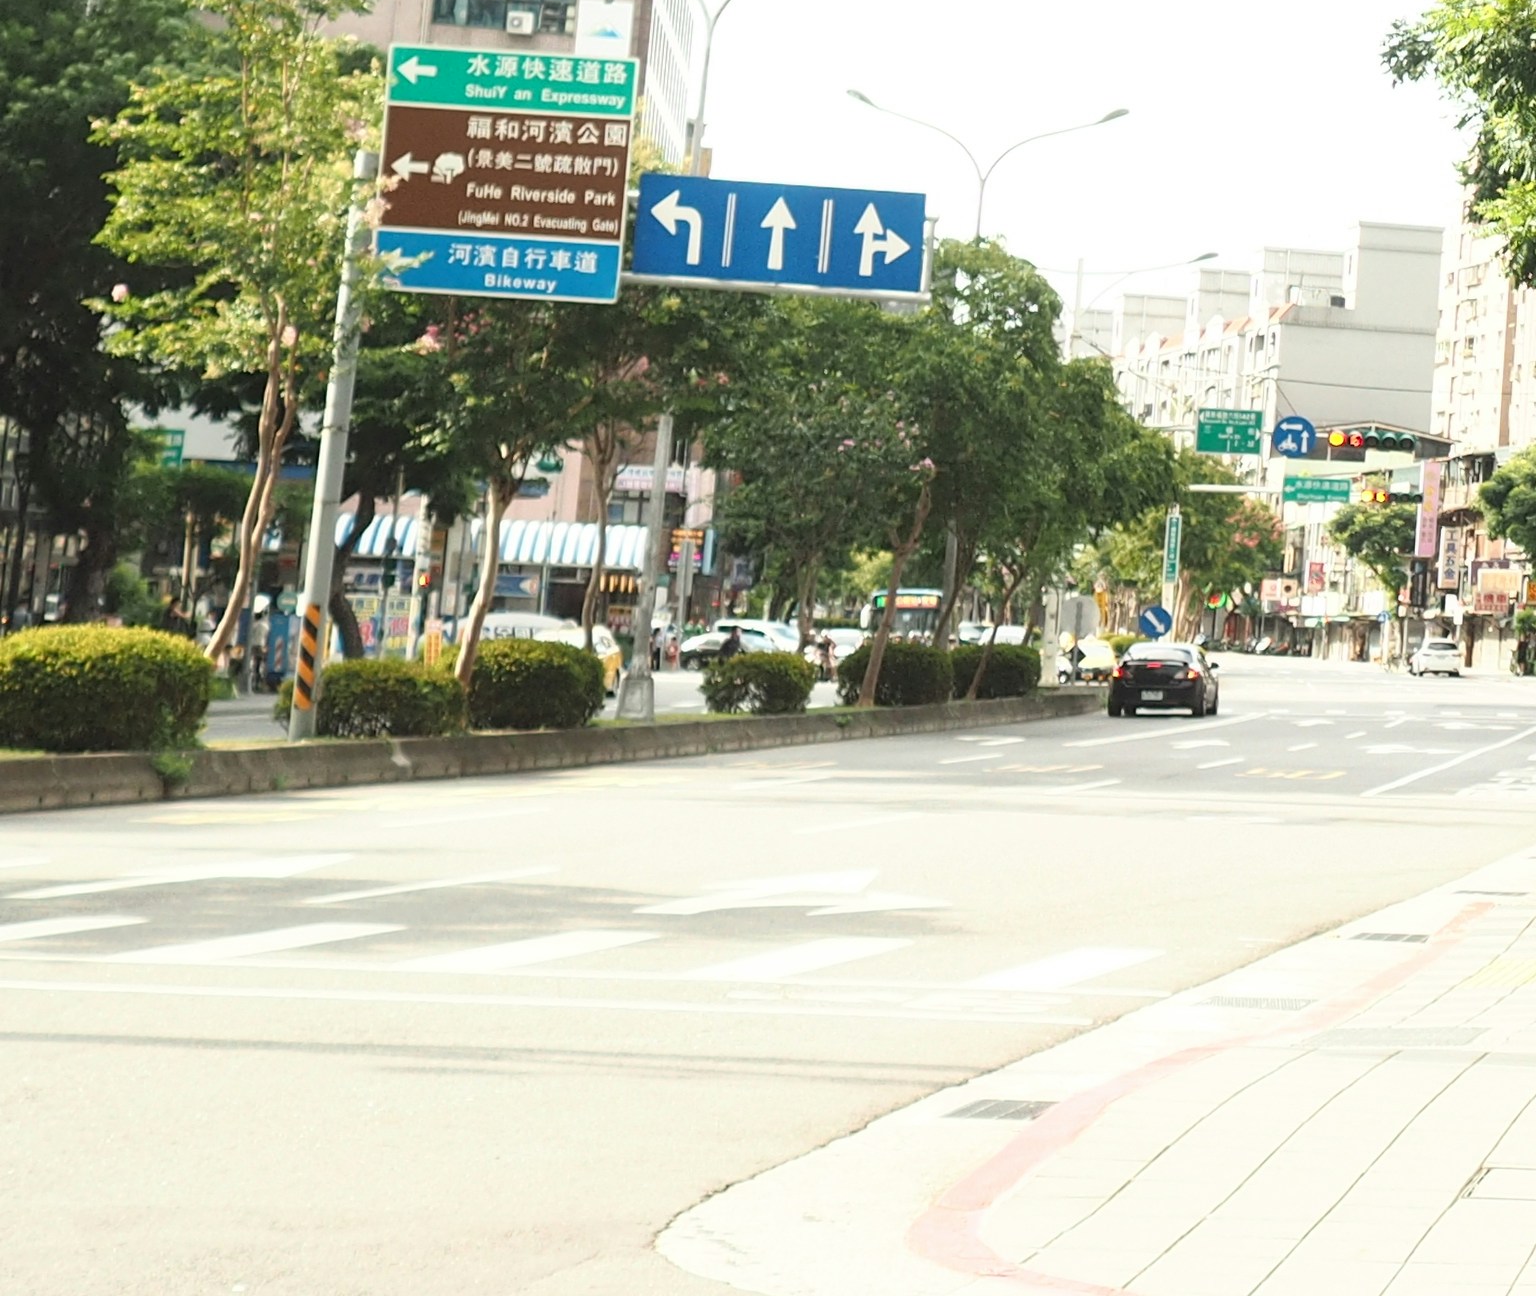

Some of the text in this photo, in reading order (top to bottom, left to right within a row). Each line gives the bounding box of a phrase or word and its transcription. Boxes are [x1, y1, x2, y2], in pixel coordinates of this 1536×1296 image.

[467, 54, 628, 85] 水源快速道路
[514, 88, 532, 101] an
[541, 88, 626, 109] Expressway
[466, 115, 628, 148] 福和河濱公園
[467, 148, 619, 178] (景美二號疏散門)
[466, 182, 616, 206] FuHe Riverside Park
[504, 212, 529, 228] NO.2
[533, 214, 588, 234] Evacuating
[592, 218, 618, 235] Gate)
[447, 243, 598, 274] 河濱自行車道
[484, 273, 557, 293] Bikeway
[1444, 529, 1458, 581] 工具五金
